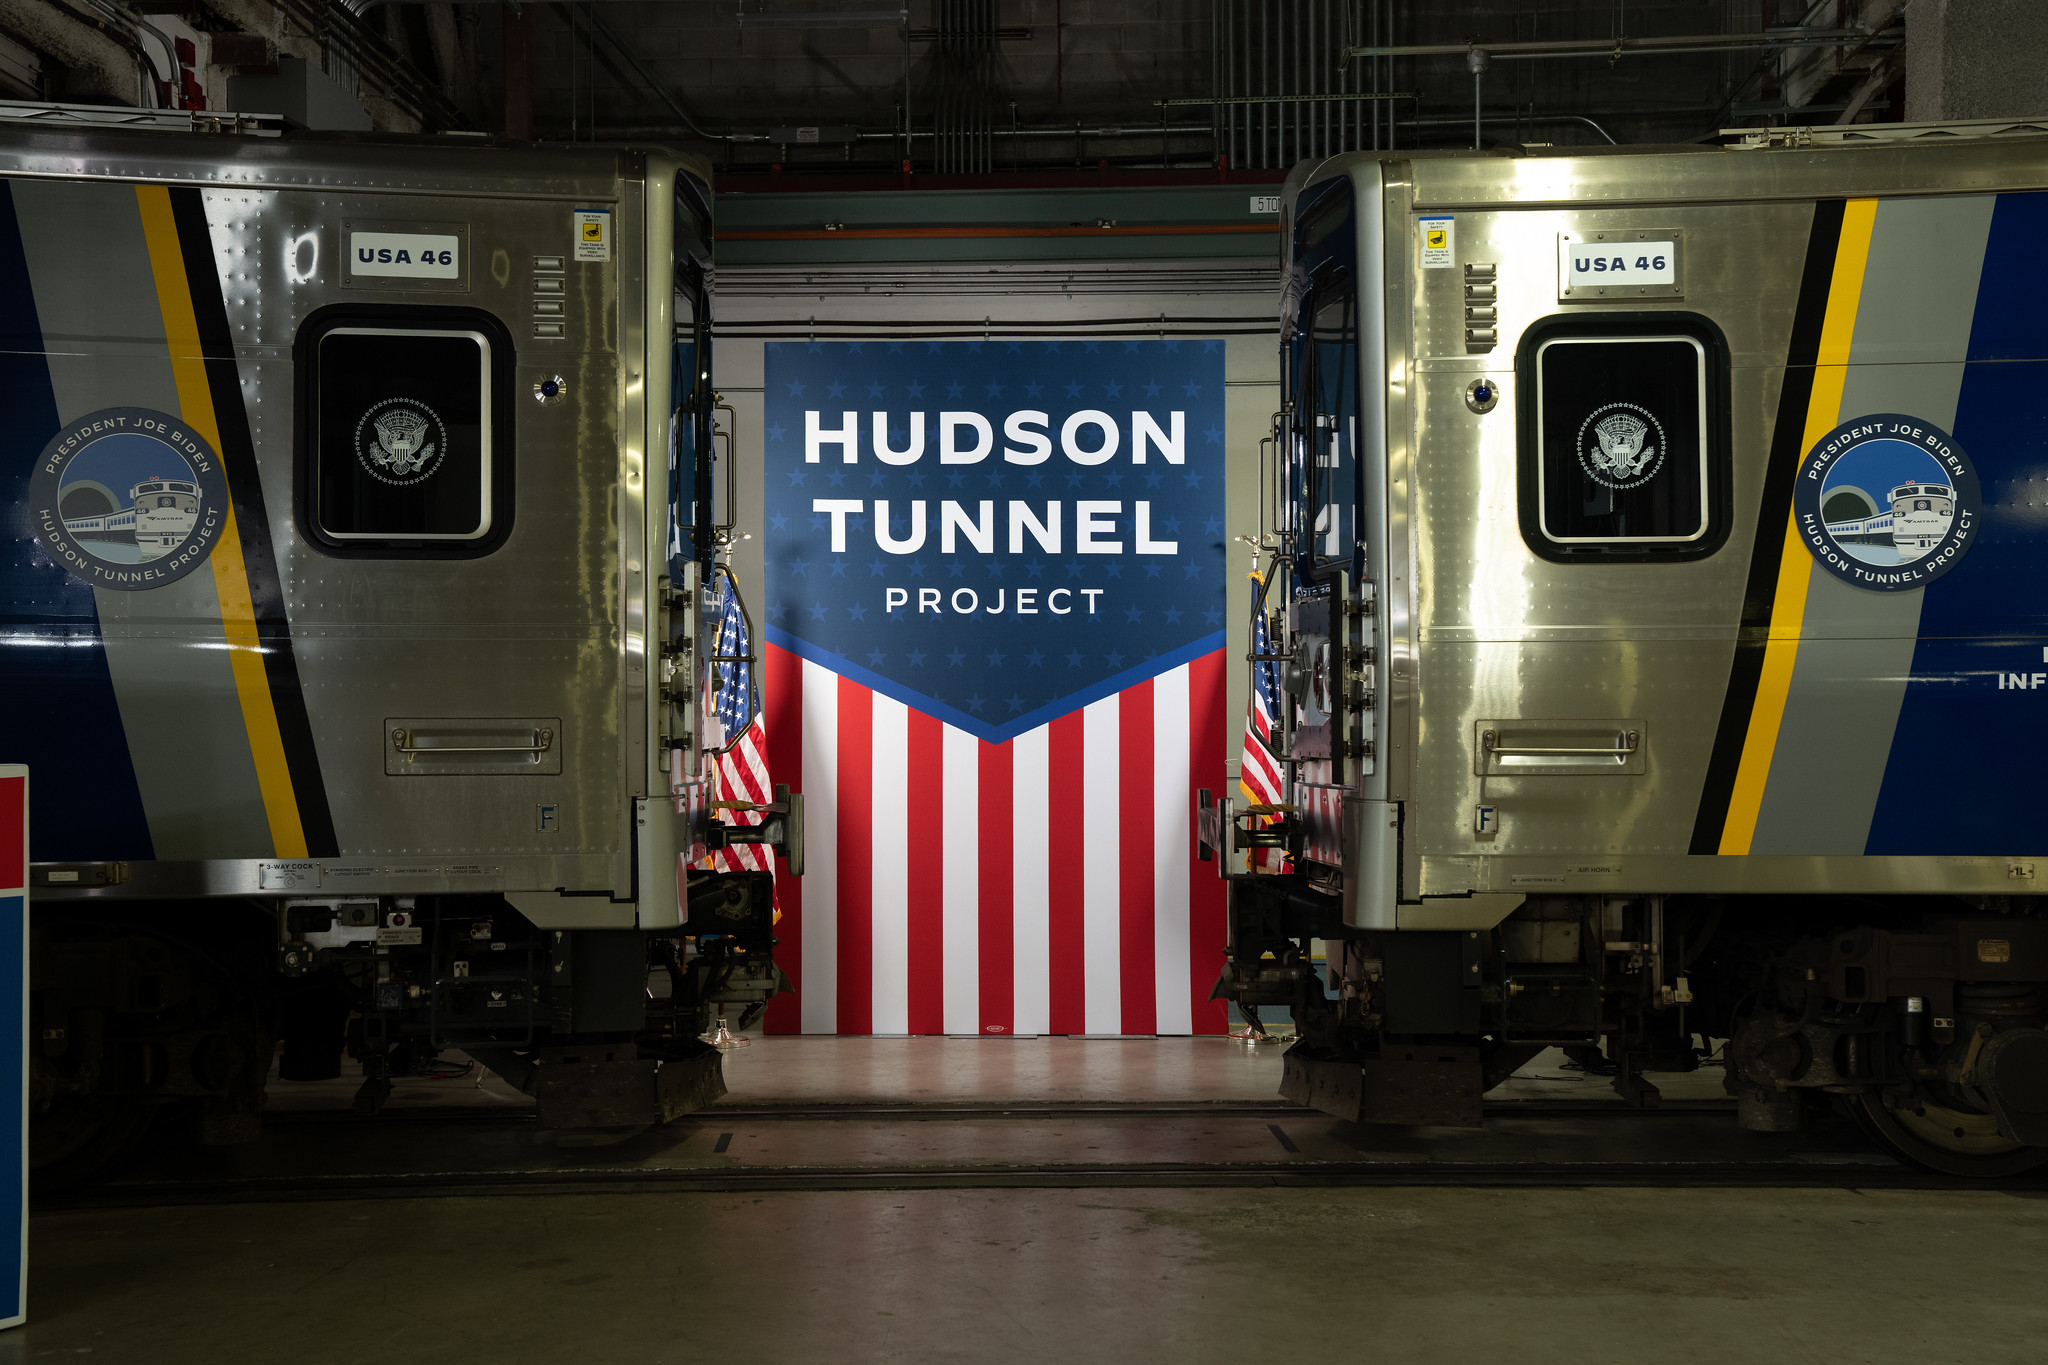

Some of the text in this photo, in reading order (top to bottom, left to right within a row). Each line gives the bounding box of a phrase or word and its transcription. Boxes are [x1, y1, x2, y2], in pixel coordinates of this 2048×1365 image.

[1258, 198, 1264, 212] 5
[358, 248, 452, 266] USA 46
[1575, 256, 1666, 273] USA 46
[45, 417, 212, 474] PRESIDENT JOE BIDEN
[804, 409, 1186, 466] HUDSON
[1808, 423, 1965, 480] PRESIDENT JOE BIDEN
[812, 498, 1179, 556] TUNNEL
[39, 506, 218, 582] HUDSON TUNNEL PROJECT
[1803, 508, 1974, 584] HUDSON TUNNEL PROJECT
[885, 587, 1105, 616] PROJECT
[541, 806, 554, 830] F
[1480, 808, 1494, 830] F
[2014, 866, 2026, 876] 1L
